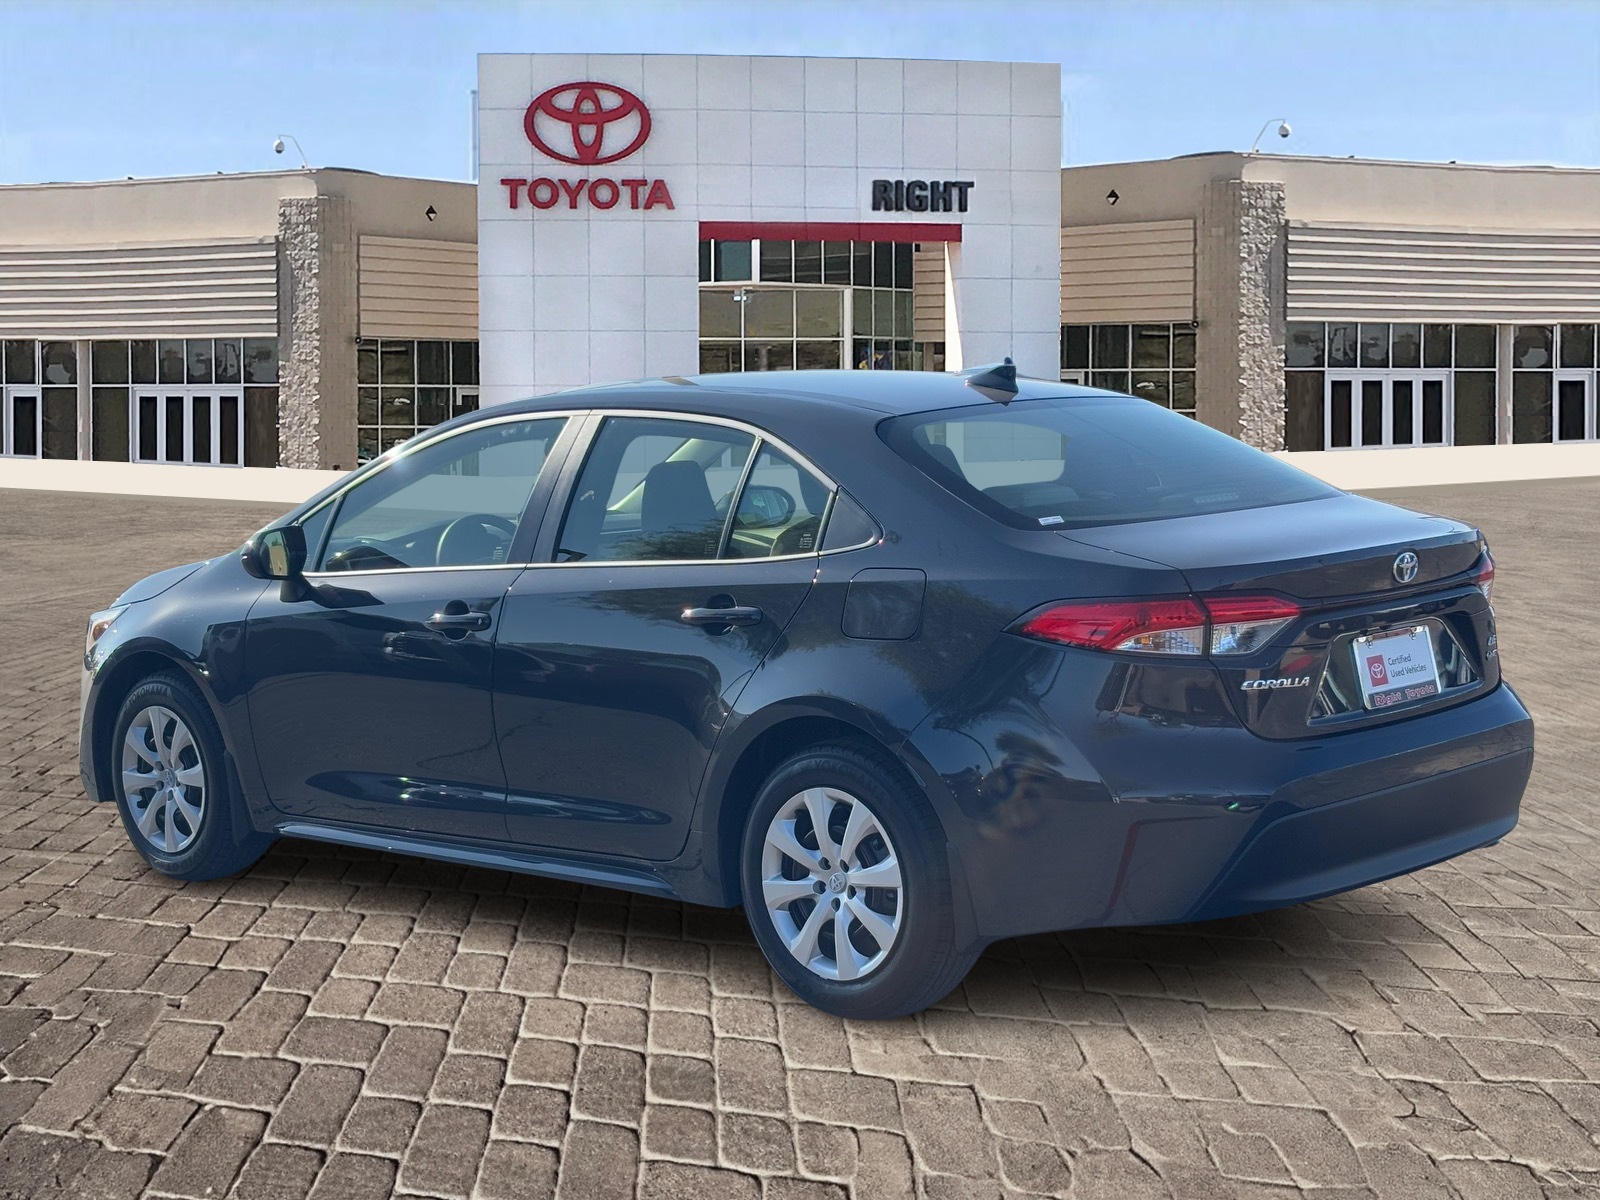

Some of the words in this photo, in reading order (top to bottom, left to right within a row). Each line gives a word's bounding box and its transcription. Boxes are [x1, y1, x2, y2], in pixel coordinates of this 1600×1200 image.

[500, 178, 675, 210] TOYOTA
[872, 180, 975, 212] RIGHT
[1388, 654, 1411, 665] Certified
[1390, 667, 1405, 678] Used
[1405, 664, 1427, 676] Vehicles
[1240, 676, 1310, 690] COROLLA
[1374, 692, 1402, 706] Right
[1405, 684, 1435, 699] Toyota
